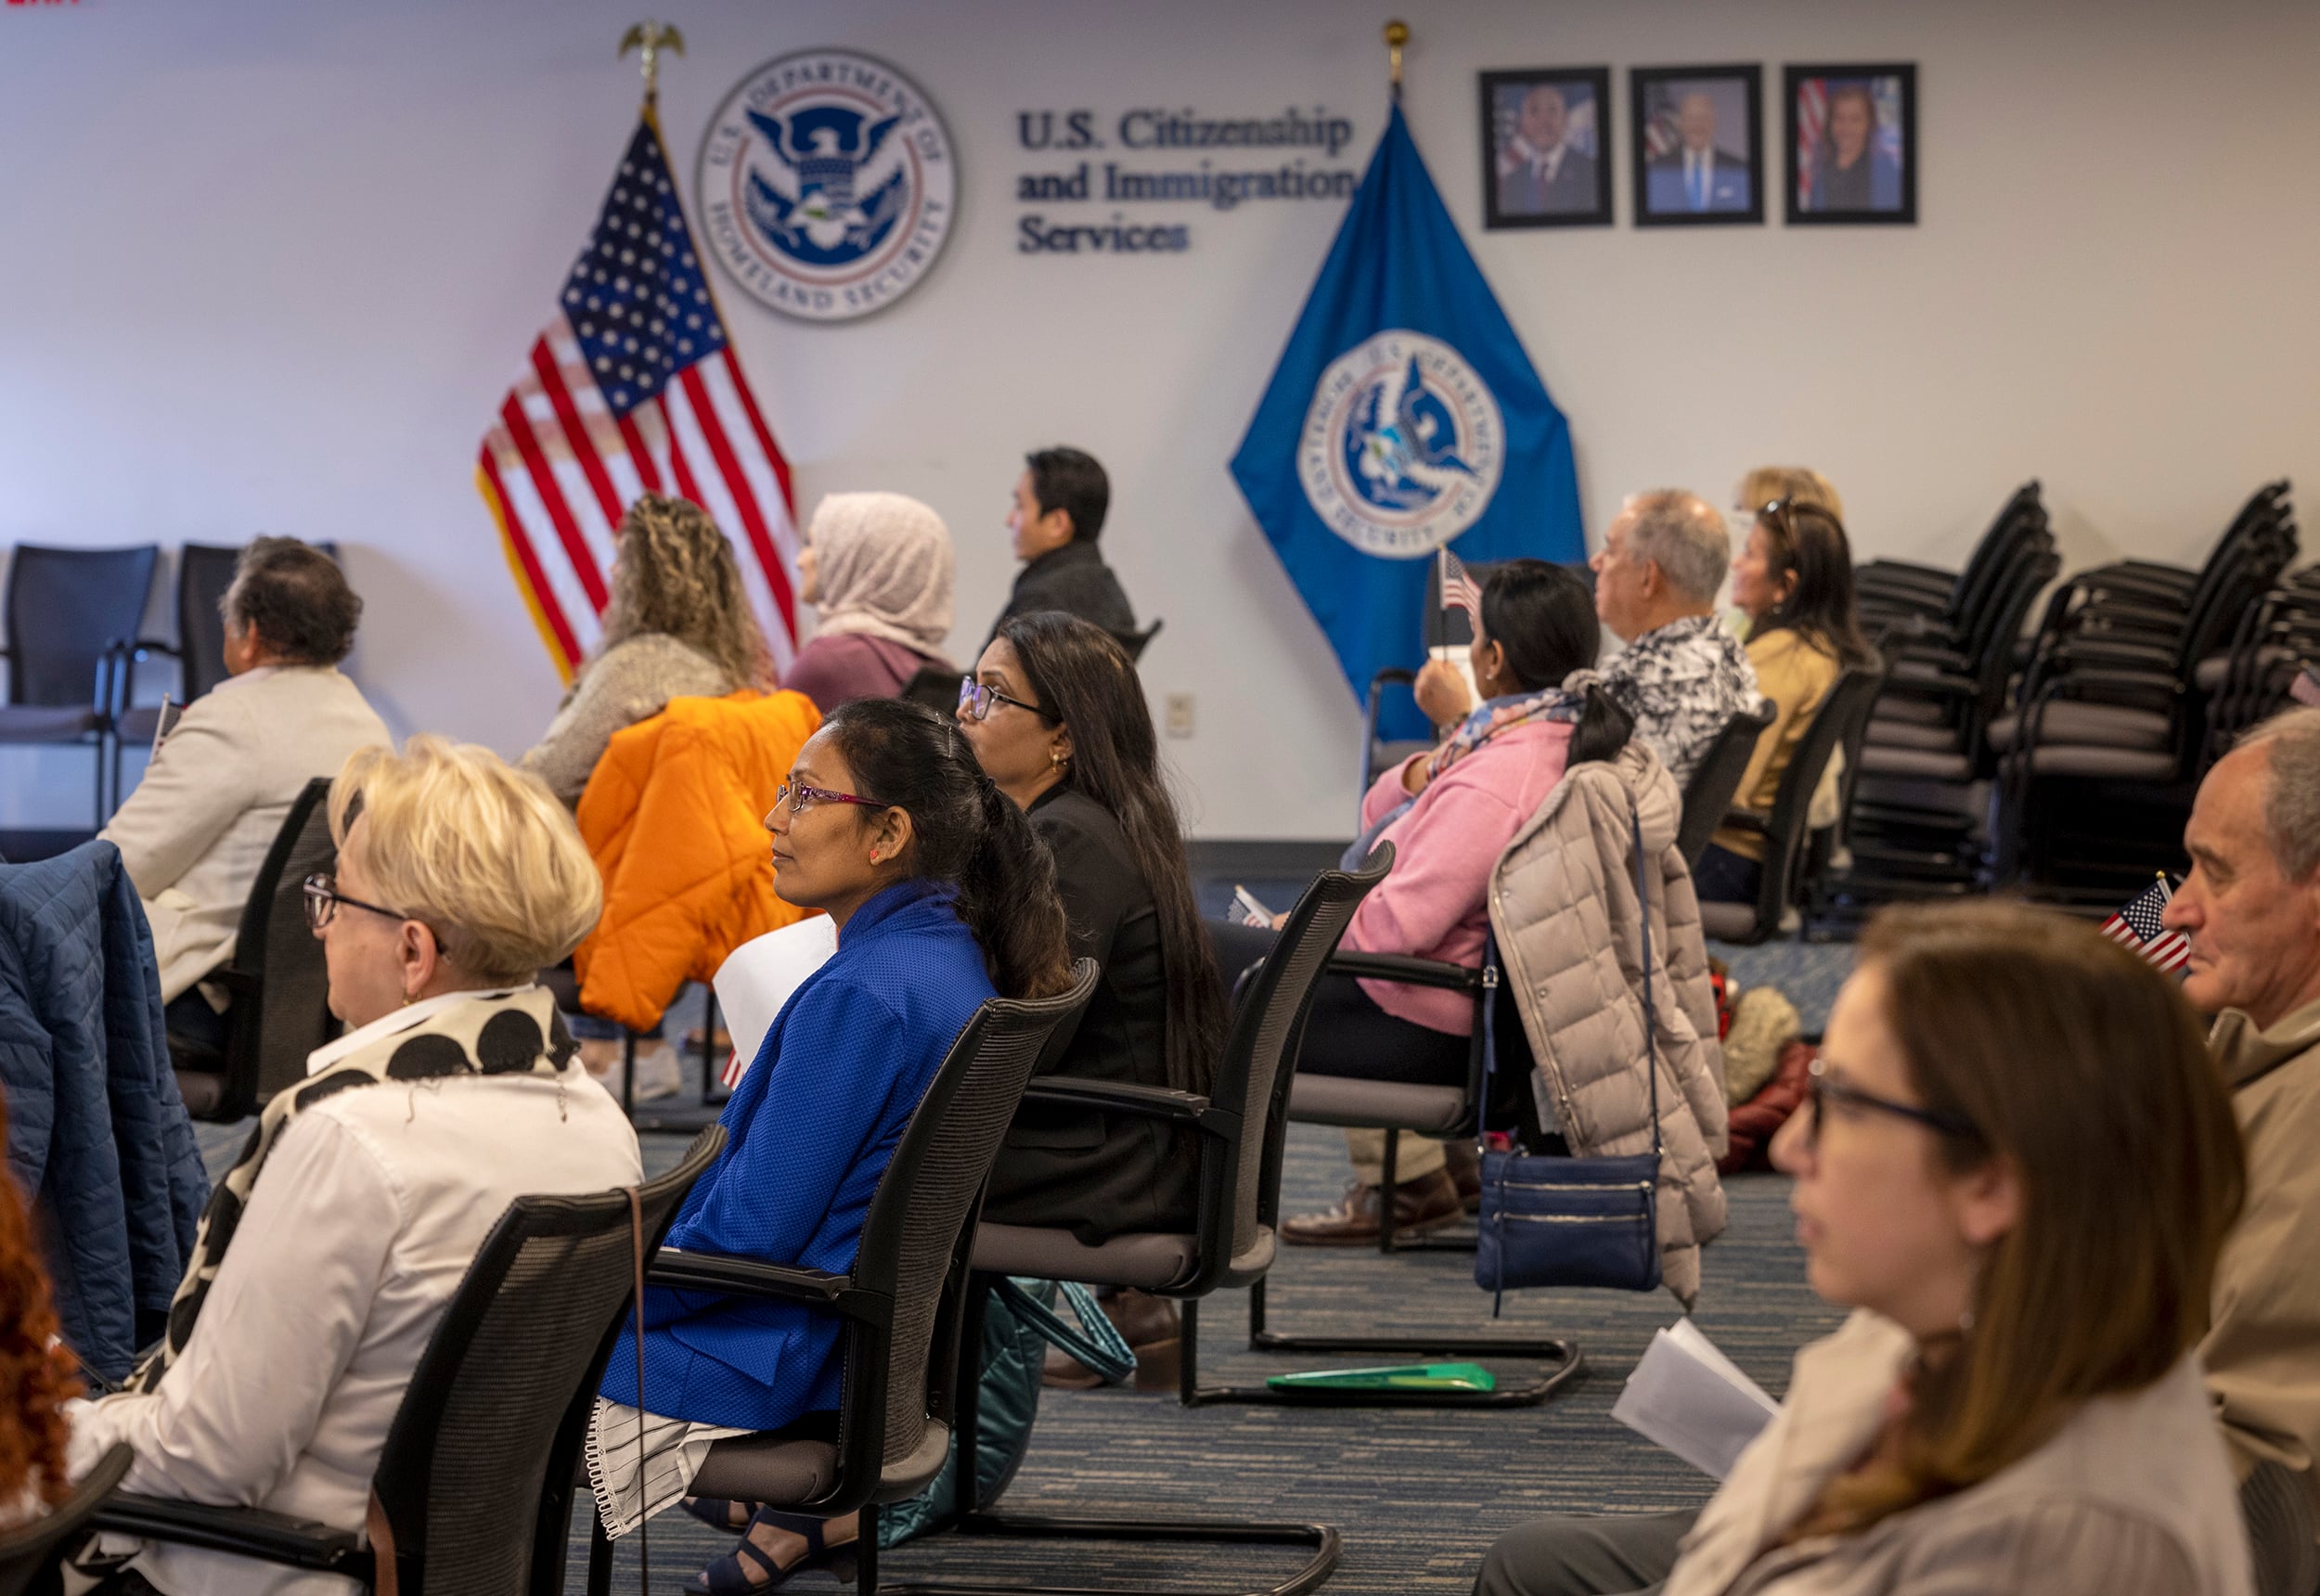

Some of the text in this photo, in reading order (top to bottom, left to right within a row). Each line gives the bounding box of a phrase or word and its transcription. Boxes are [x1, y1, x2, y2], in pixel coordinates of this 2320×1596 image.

[748, 62, 923, 122] DEPARTMENT
[916, 127, 943, 162] OF
[1017, 106, 1354, 158] U.S. Citizenship
[1017, 160, 1356, 211] and Immigration
[709, 200, 944, 308] HOMELAND SECURITY
[1018, 213, 1189, 253] Services
